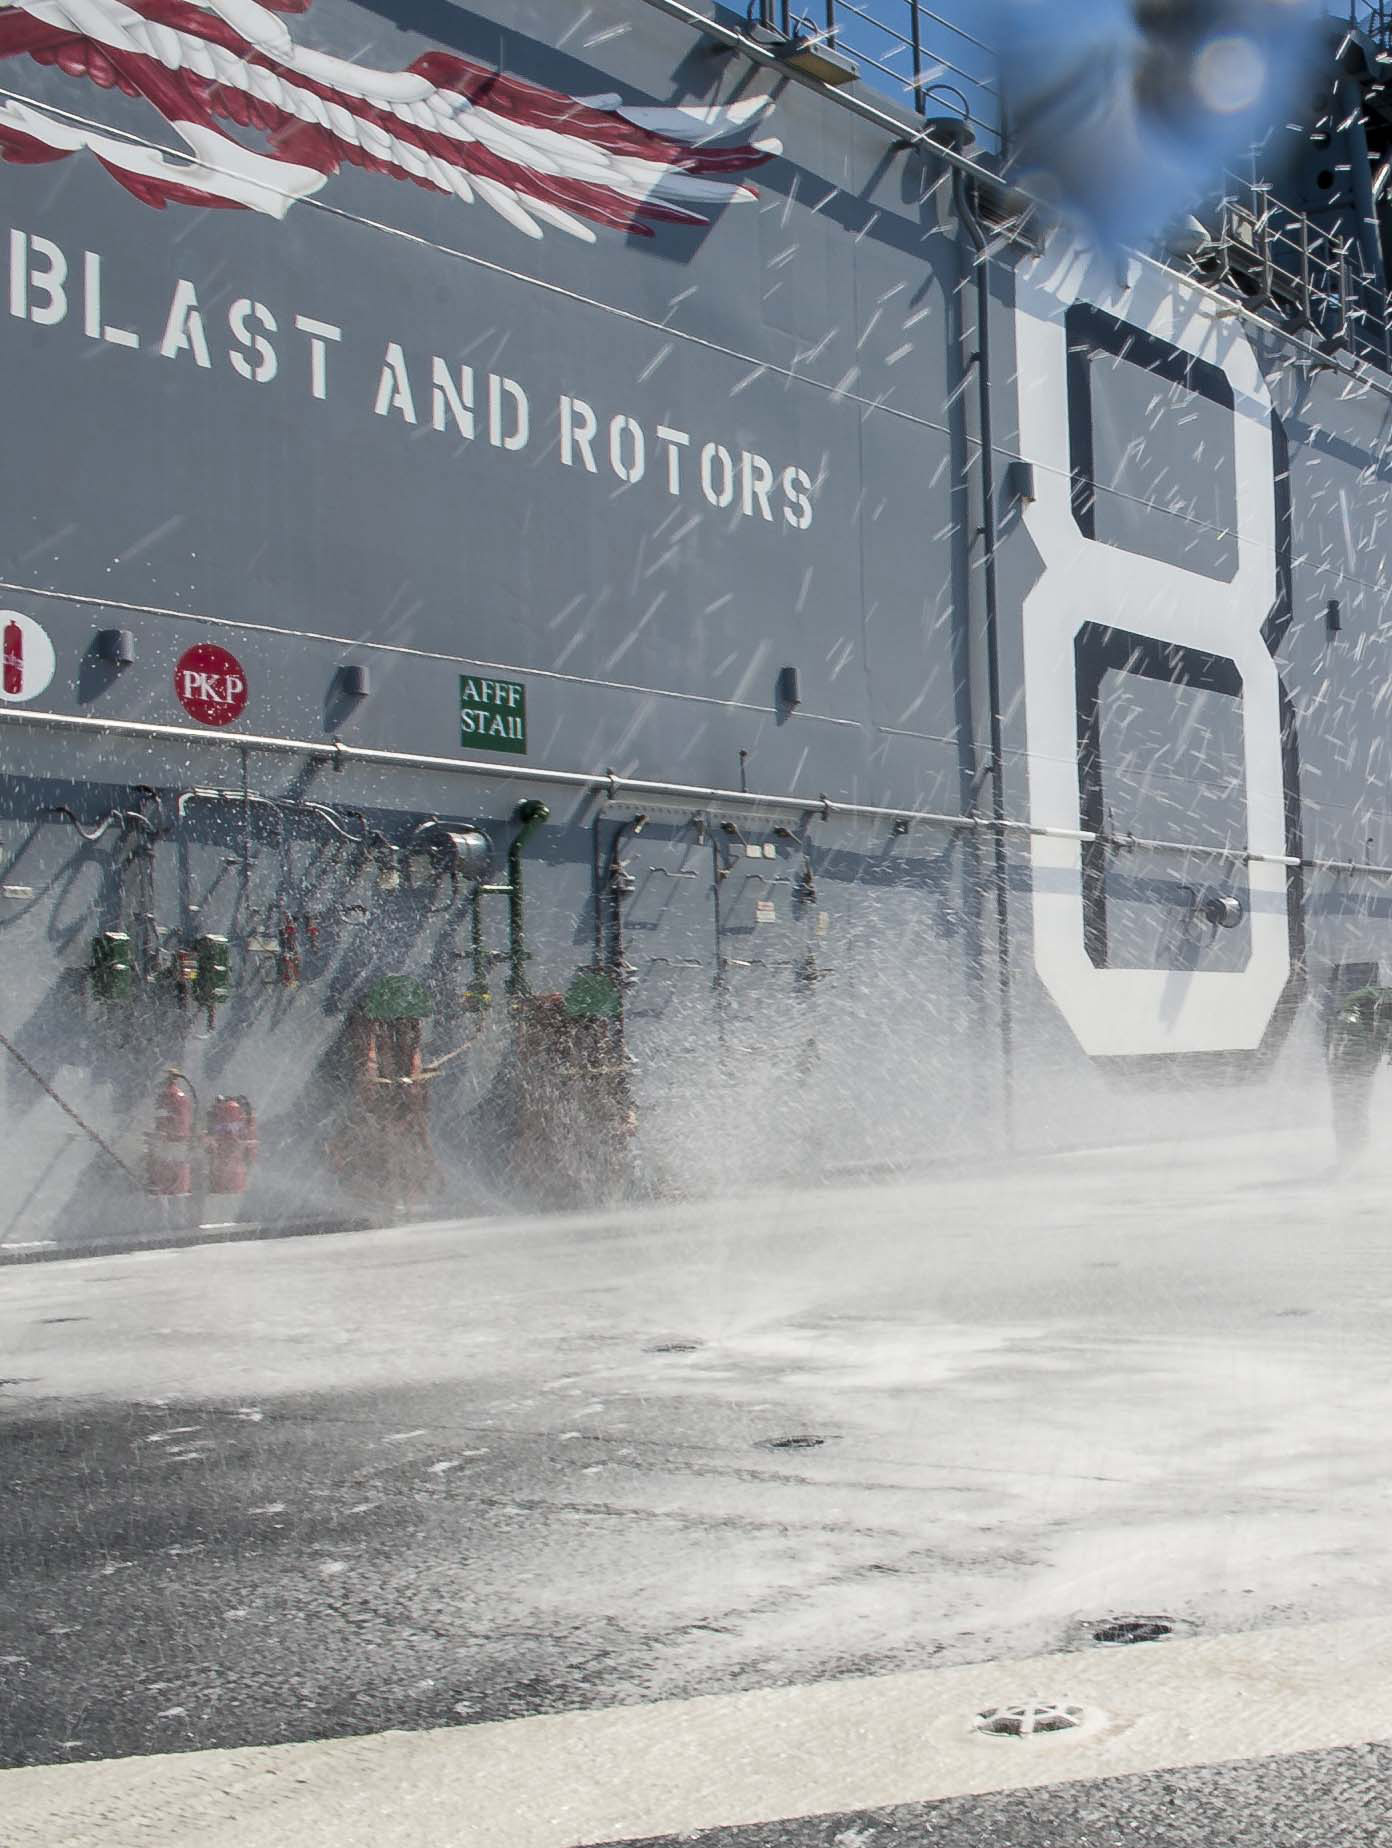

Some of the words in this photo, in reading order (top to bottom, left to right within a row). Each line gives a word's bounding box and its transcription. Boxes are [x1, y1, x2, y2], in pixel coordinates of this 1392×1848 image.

[9, 229, 342, 401] BLAST
[375, 342, 531, 452] AND
[560, 395, 814, 532] ROTORS
[183, 670, 243, 704] PKP
[462, 679, 522, 708] AFFF
[1015, 245, 1292, 1056] 8
